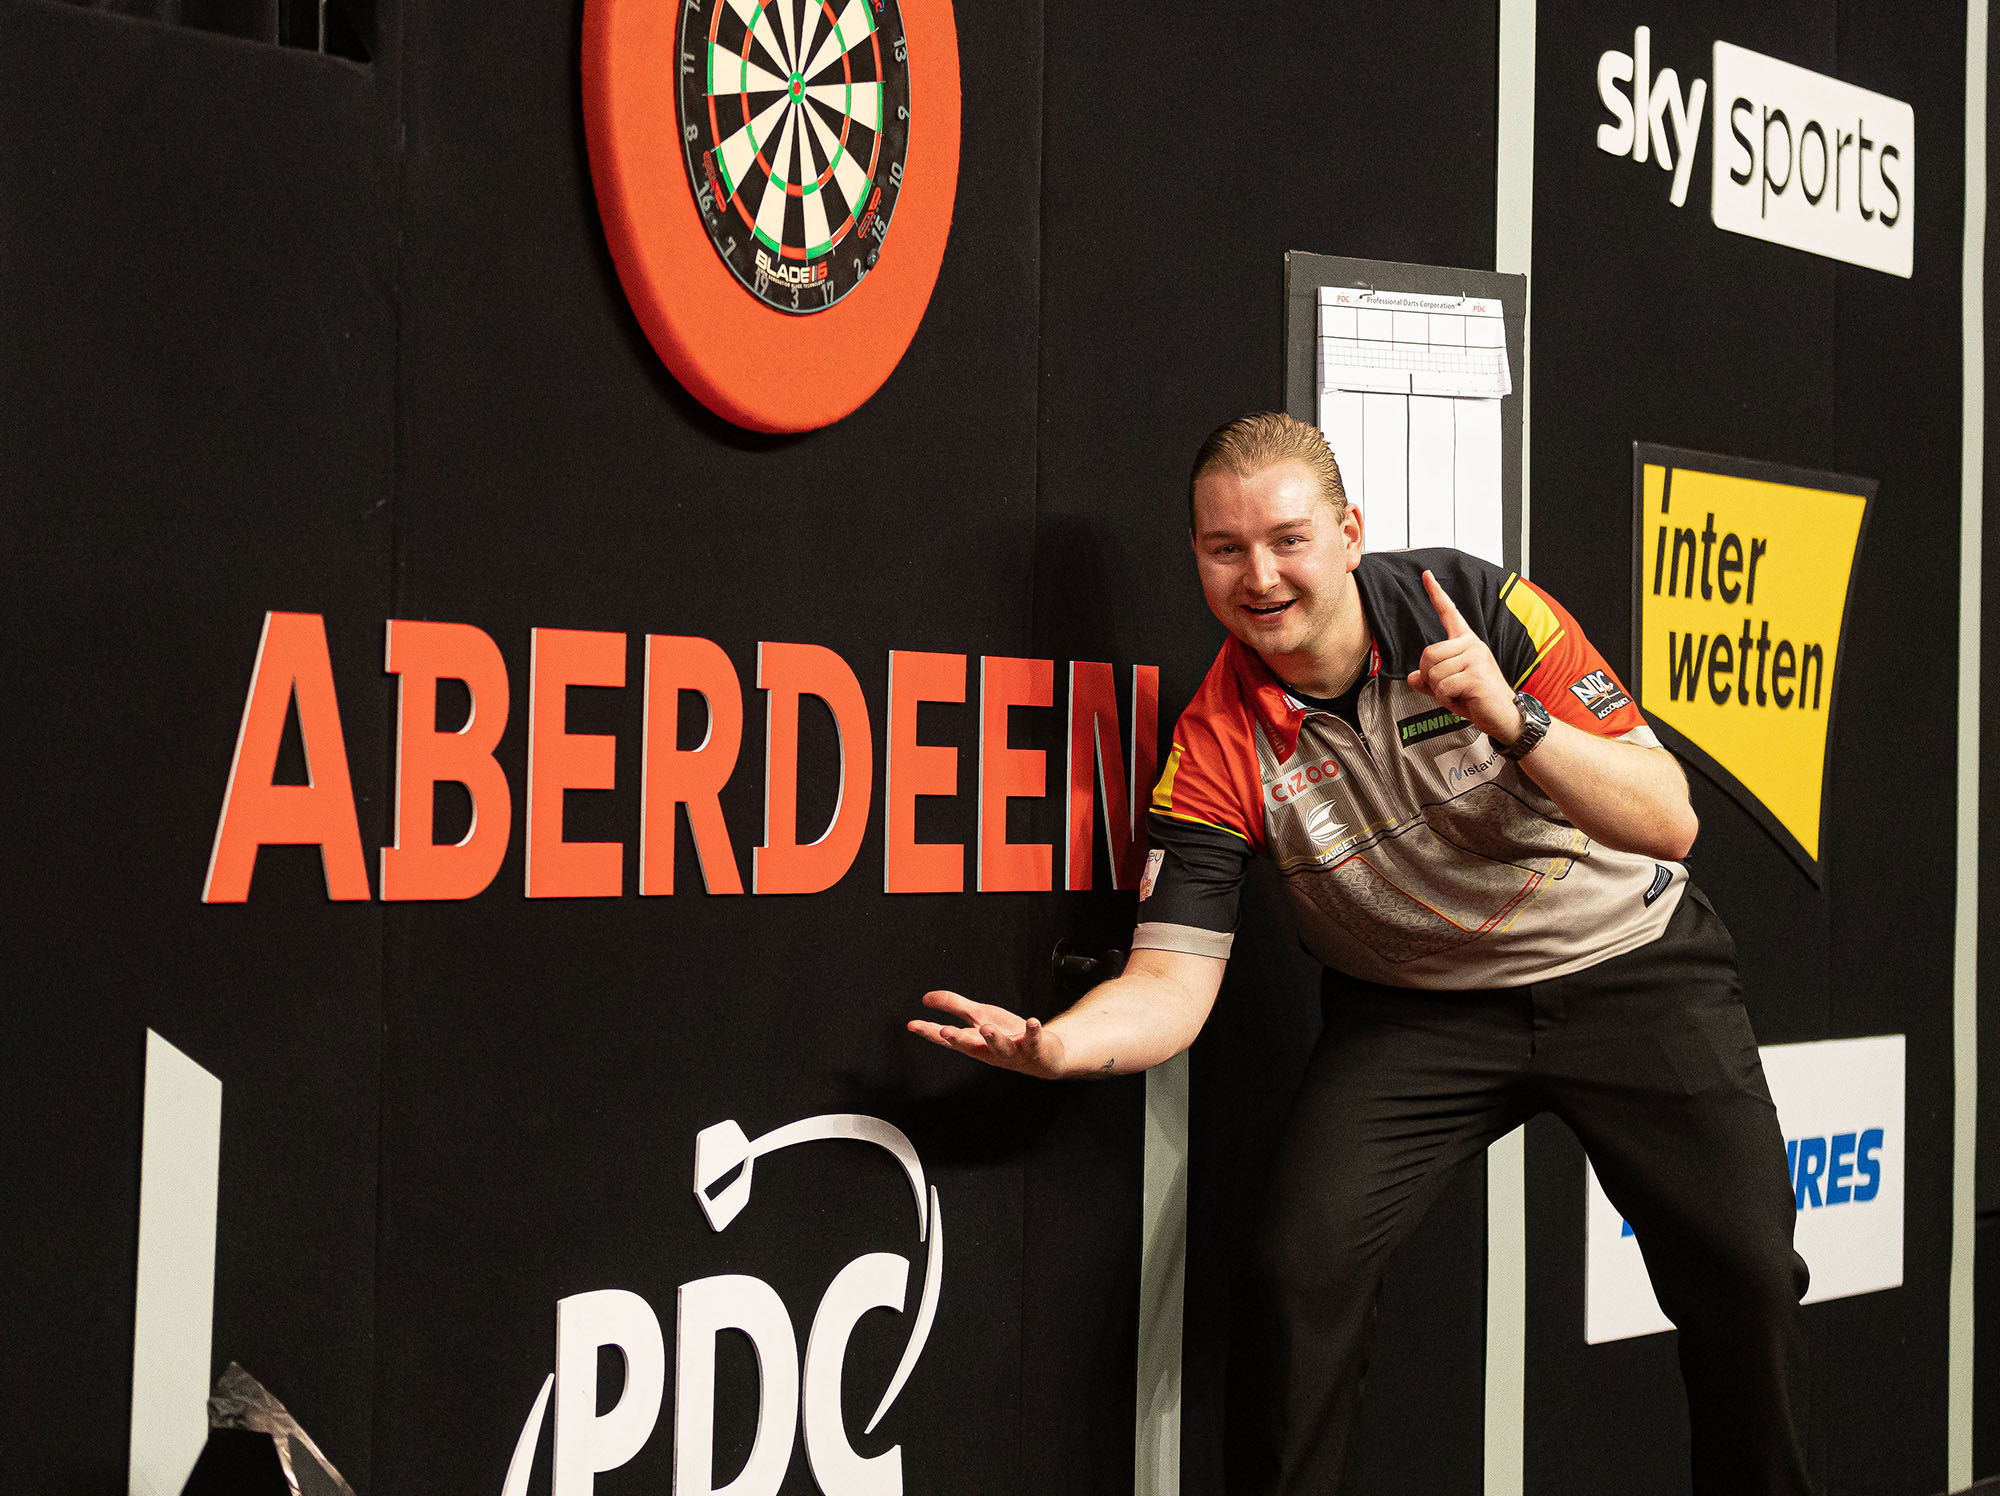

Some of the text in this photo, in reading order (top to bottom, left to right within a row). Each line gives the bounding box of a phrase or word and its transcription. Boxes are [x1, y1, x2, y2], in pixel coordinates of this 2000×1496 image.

[893, 36, 907, 62] 13
[683, 53, 696, 75] 11
[686, 123, 698, 141] 8
[1597, 25, 1900, 228] sky sports
[889, 162, 903, 189] 10
[698, 180, 715, 212] 16
[872, 215, 887, 243] 15
[724, 236, 737, 257] 7
[755, 249, 809, 284] BLADE
[853, 258, 863, 281] 2
[754, 267, 769, 296] 19
[821, 280, 834, 305] 17
[791, 287, 799, 310] 3
[1336, 294, 1350, 303] PDC
[1366, 296, 1456, 311] Professional Darts Corporation
[1653, 467, 1767, 605] inter
[1669, 619, 1823, 711] wetten
[201, 611, 1160, 904] ABERDEEN
[1316, 835, 1358, 865] TARGET
[552, 1252, 910, 1496] PDC
